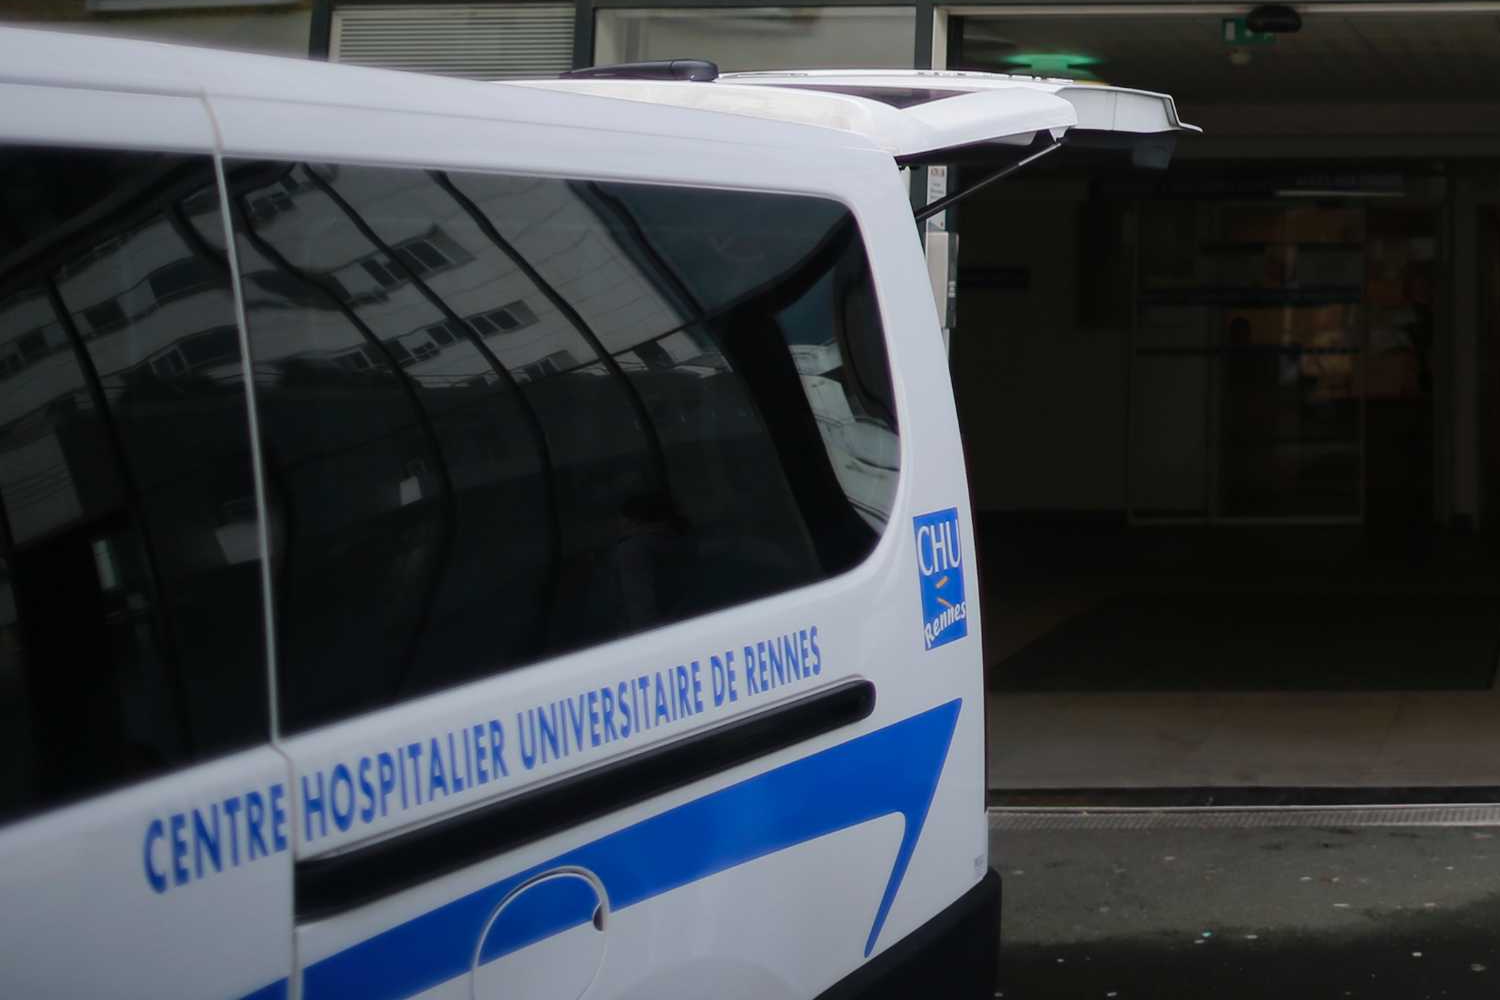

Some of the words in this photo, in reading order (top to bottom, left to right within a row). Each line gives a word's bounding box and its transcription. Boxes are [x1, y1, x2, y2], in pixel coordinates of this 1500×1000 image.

[916, 519, 961, 576] CHU
[924, 600, 966, 649] Rennes
[143, 783, 288, 894] CENTRE
[303, 718, 509, 841] HOSPITALIER
[516, 661, 704, 771] UNIVERSITAIRE
[710, 651, 738, 708] DE
[743, 625, 822, 697] RENNES
